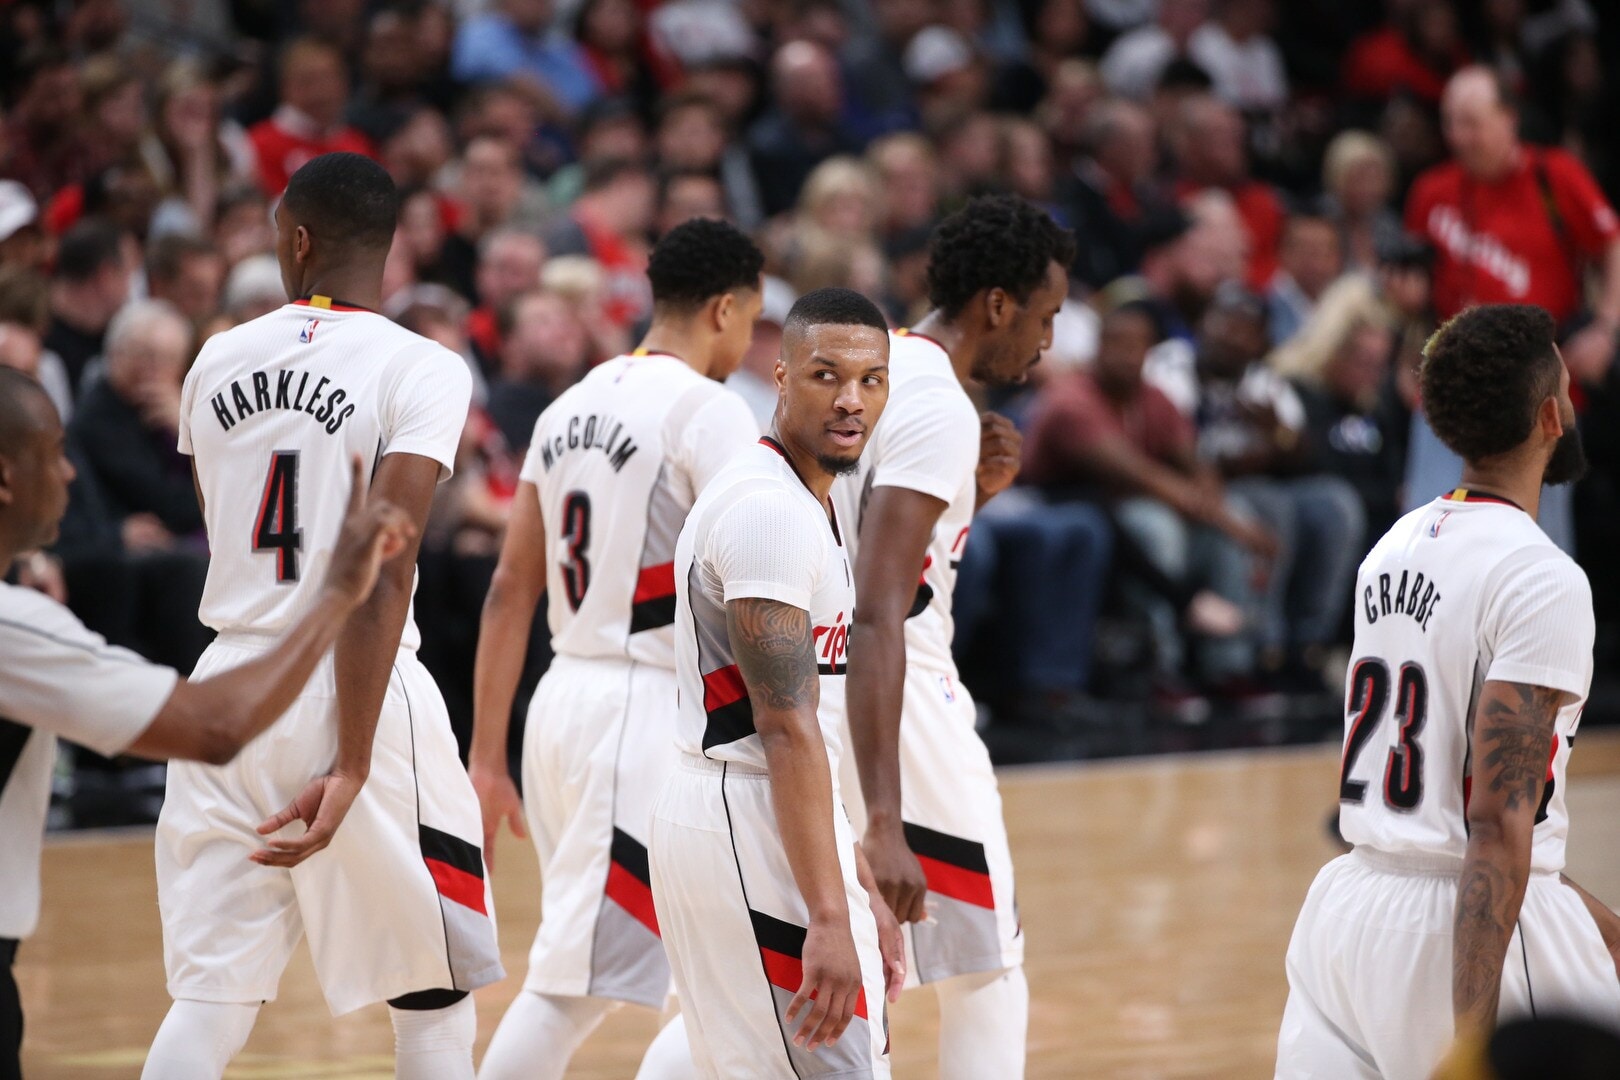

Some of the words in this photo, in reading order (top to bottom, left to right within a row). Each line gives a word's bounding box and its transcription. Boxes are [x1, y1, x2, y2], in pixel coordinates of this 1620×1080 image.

[211, 369, 355, 435] HARKLESS
[252, 450, 304, 585] 4
[559, 488, 591, 614] 3
[1364, 569, 1441, 633] CRABBE
[1340, 656, 1429, 814] 23
